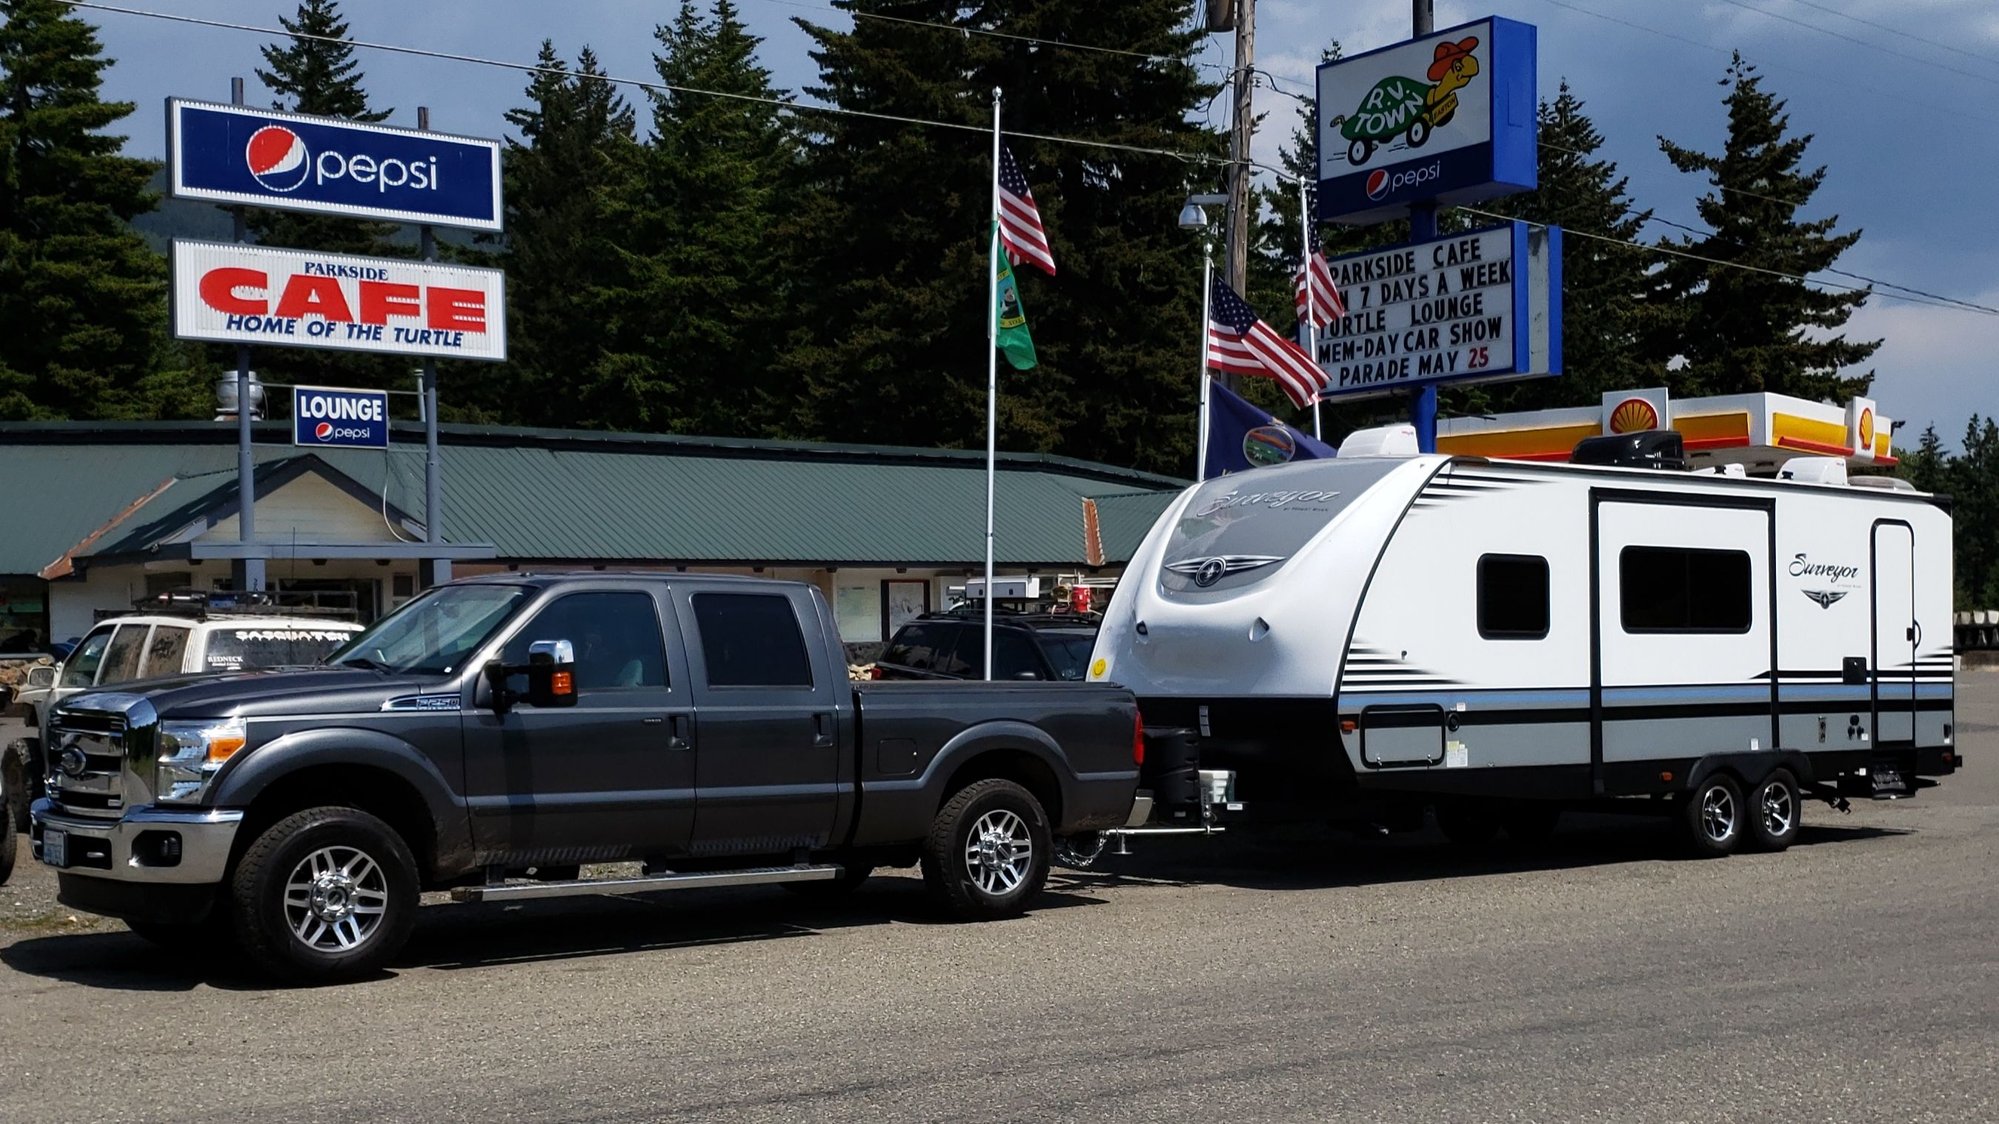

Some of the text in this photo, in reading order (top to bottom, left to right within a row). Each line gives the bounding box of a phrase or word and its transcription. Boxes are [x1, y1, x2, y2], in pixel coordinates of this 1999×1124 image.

[1353, 90, 1424, 134] TOWN
[316, 149, 437, 193] pepsi
[1392, 160, 1441, 191] pepsi
[304, 262, 389, 281] PARKSIDE
[1329, 238, 1481, 284] PARKSIDE CAFE
[199, 267, 487, 334] CAFE
[1360, 286, 1370, 308] 7
[1381, 274, 1429, 304] DAYS
[1436, 272, 1448, 296] A
[1460, 260, 1511, 291] WEEK
[1411, 293, 1483, 326] LOUNGE
[226, 315, 463, 347] HOME OF THE TURTLE
[1318, 317, 1502, 364] MEM-DAY CAR SHOW
[1340, 347, 1489, 387] PARADE MAY 25
[300, 395, 383, 421] LOUNGE
[334, 426, 370, 439] pepsi
[1788, 552, 1859, 583] Surveyor
[235, 630, 350, 642] SASQUATCH
